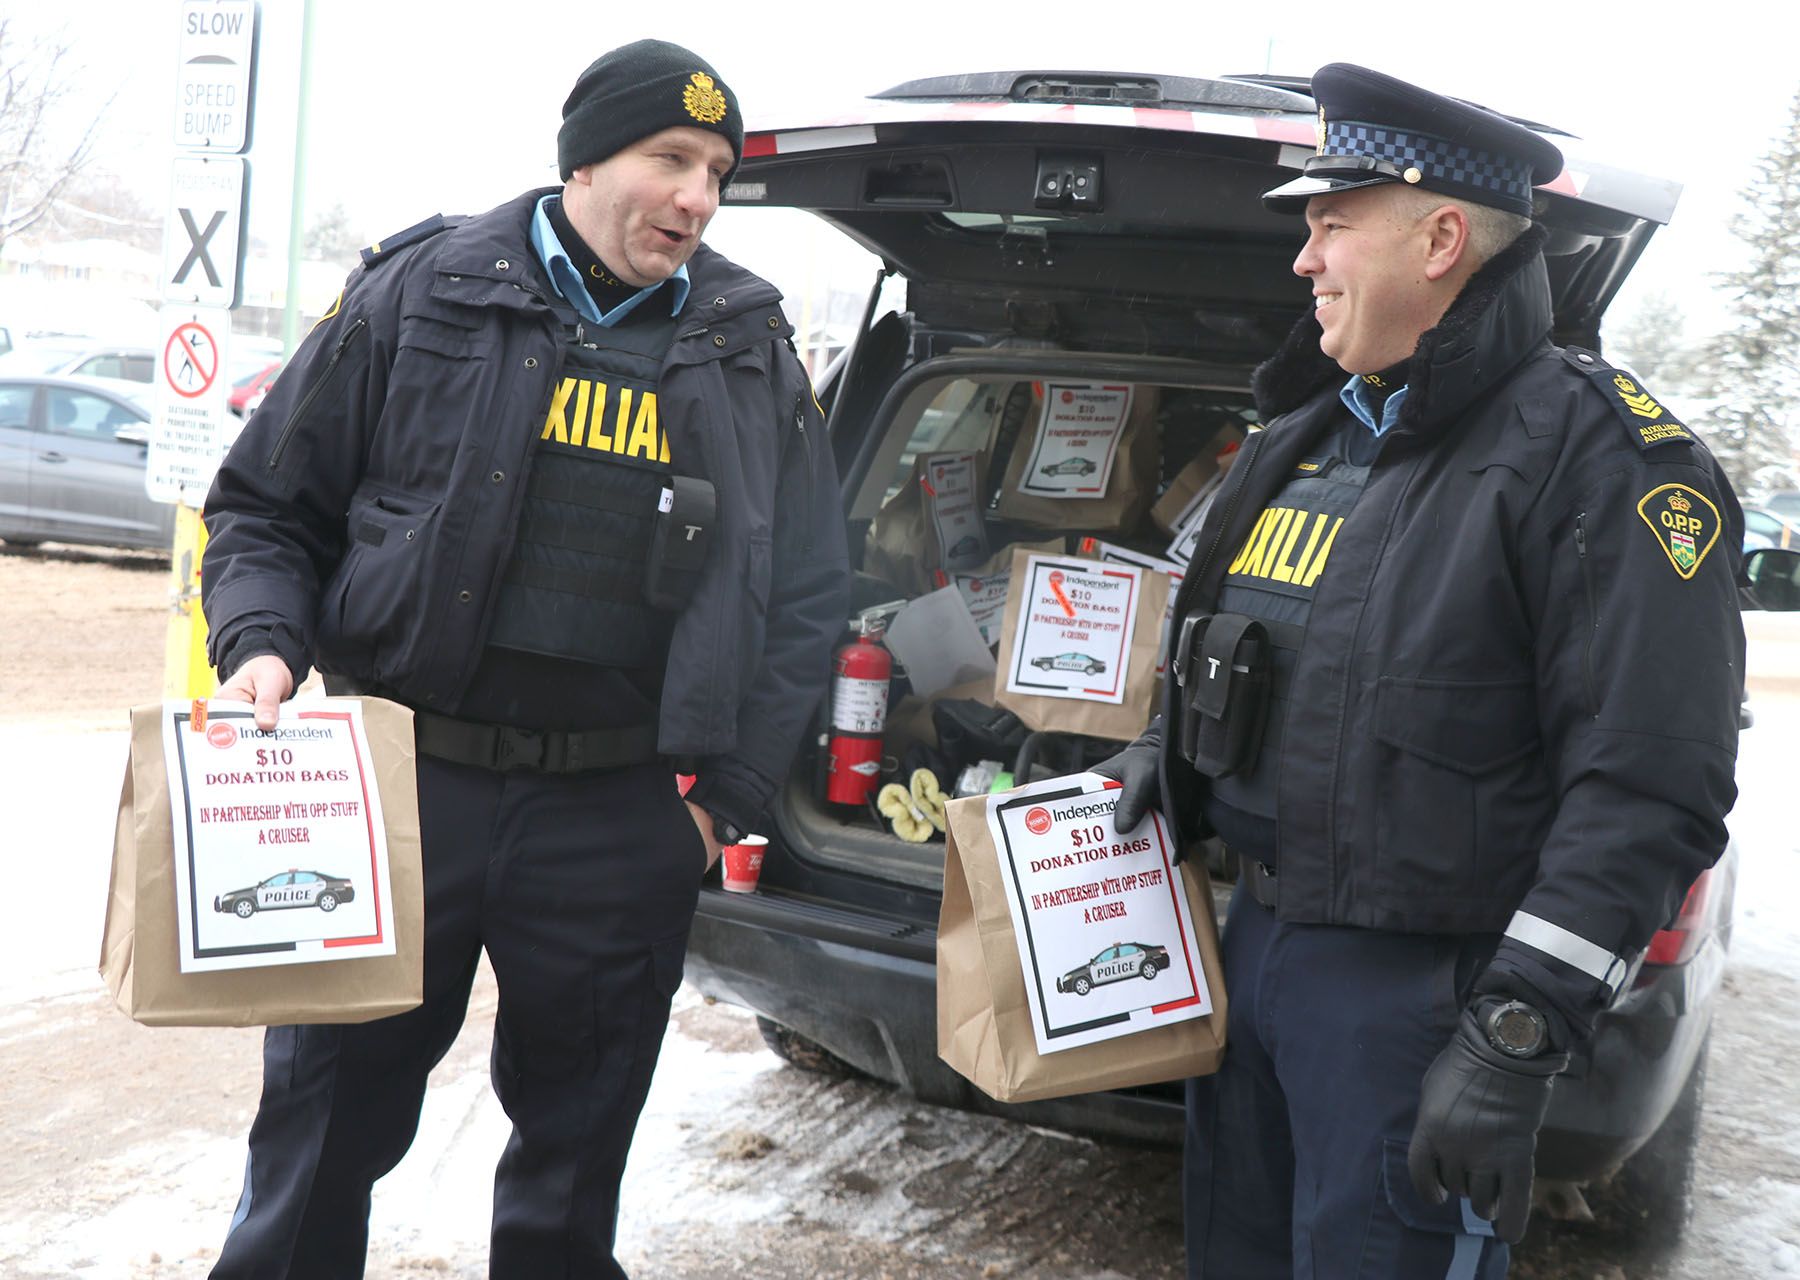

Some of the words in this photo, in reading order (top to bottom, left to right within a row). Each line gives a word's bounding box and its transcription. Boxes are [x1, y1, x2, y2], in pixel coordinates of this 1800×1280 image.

[187, 12, 243, 35] SLOW
[184, 83, 236, 107] SPEED
[184, 112, 232, 135] BUMP
[1661, 510, 1703, 536] O.P.P.
[1066, 575, 1119, 589] Independent
[1042, 597, 1089, 609] DONTION
[1071, 589, 1092, 600] $10
[240, 726, 333, 741] Independent
[256, 748, 293, 767] $10
[206, 770, 296, 785] DONATION
[301, 770, 349, 783] BAGS
[200, 807, 211, 824] IN
[213, 804, 282, 823] PARTNERSHIP
[284, 801, 308, 819] WITH
[310, 802, 329, 818] OPP
[331, 801, 359, 817] STUFF
[258, 829, 267, 845] A
[268, 827, 310, 844] CRUISER
[1071, 825, 1104, 848] $10
[1030, 847, 1109, 873] DONATION
[1112, 838, 1151, 858] BAGS
[265, 889, 311, 903] POLICE
[1031, 895, 1042, 910] IN
[1043, 882, 1100, 909] PARTNERSHIP
[1101, 877, 1121, 897] WITH
[1122, 874, 1138, 893] OPP
[1139, 869, 1163, 888] STUFF
[1084, 909, 1092, 924] A
[1092, 901, 1127, 922] CRUISER
[1096, 962, 1135, 979] POLICE
